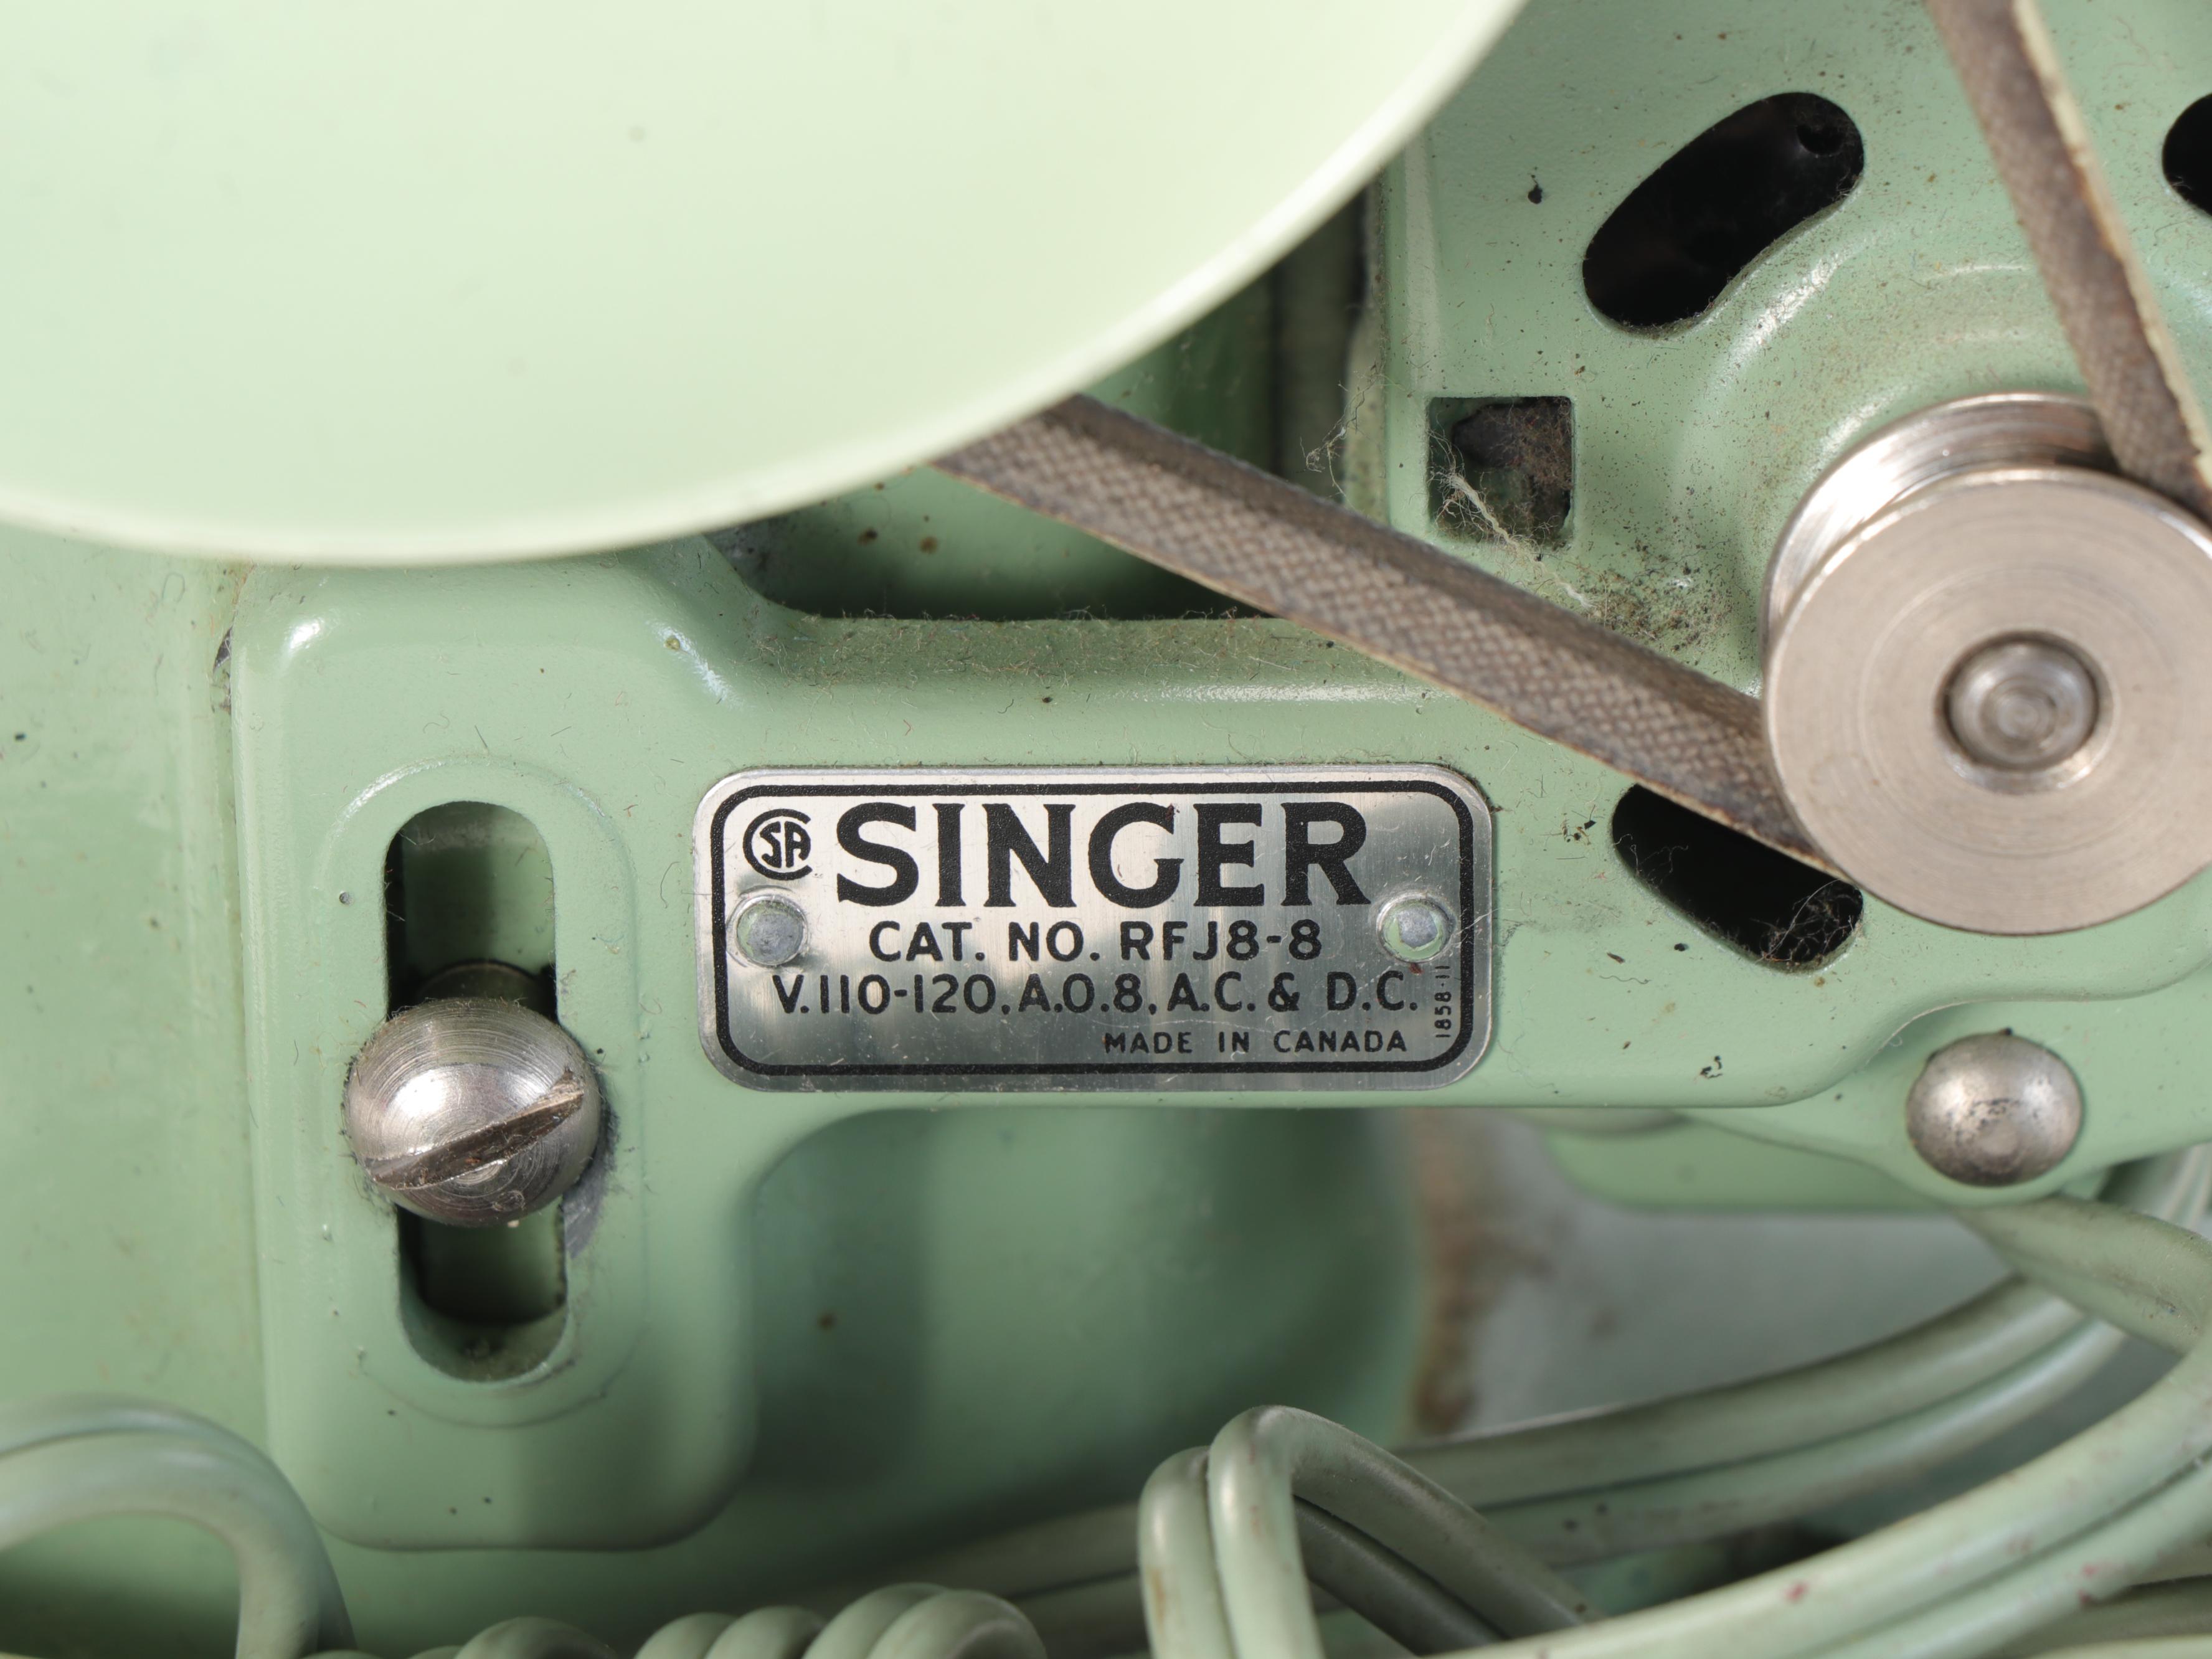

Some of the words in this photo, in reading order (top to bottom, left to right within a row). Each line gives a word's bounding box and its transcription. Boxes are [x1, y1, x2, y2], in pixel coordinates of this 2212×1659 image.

[836, 801, 1371, 908] SINGER
[869, 920, 985, 962] CAT.
[1008, 920, 1100, 962] NO.
[1120, 919, 1323, 960] RFJ8-8
[1327, 970, 1418, 1011] D.C.
[1104, 1031, 1193, 1054] MADE
[1219, 1031, 1249, 1052] IN
[1274, 1030, 1407, 1052] CANADA
